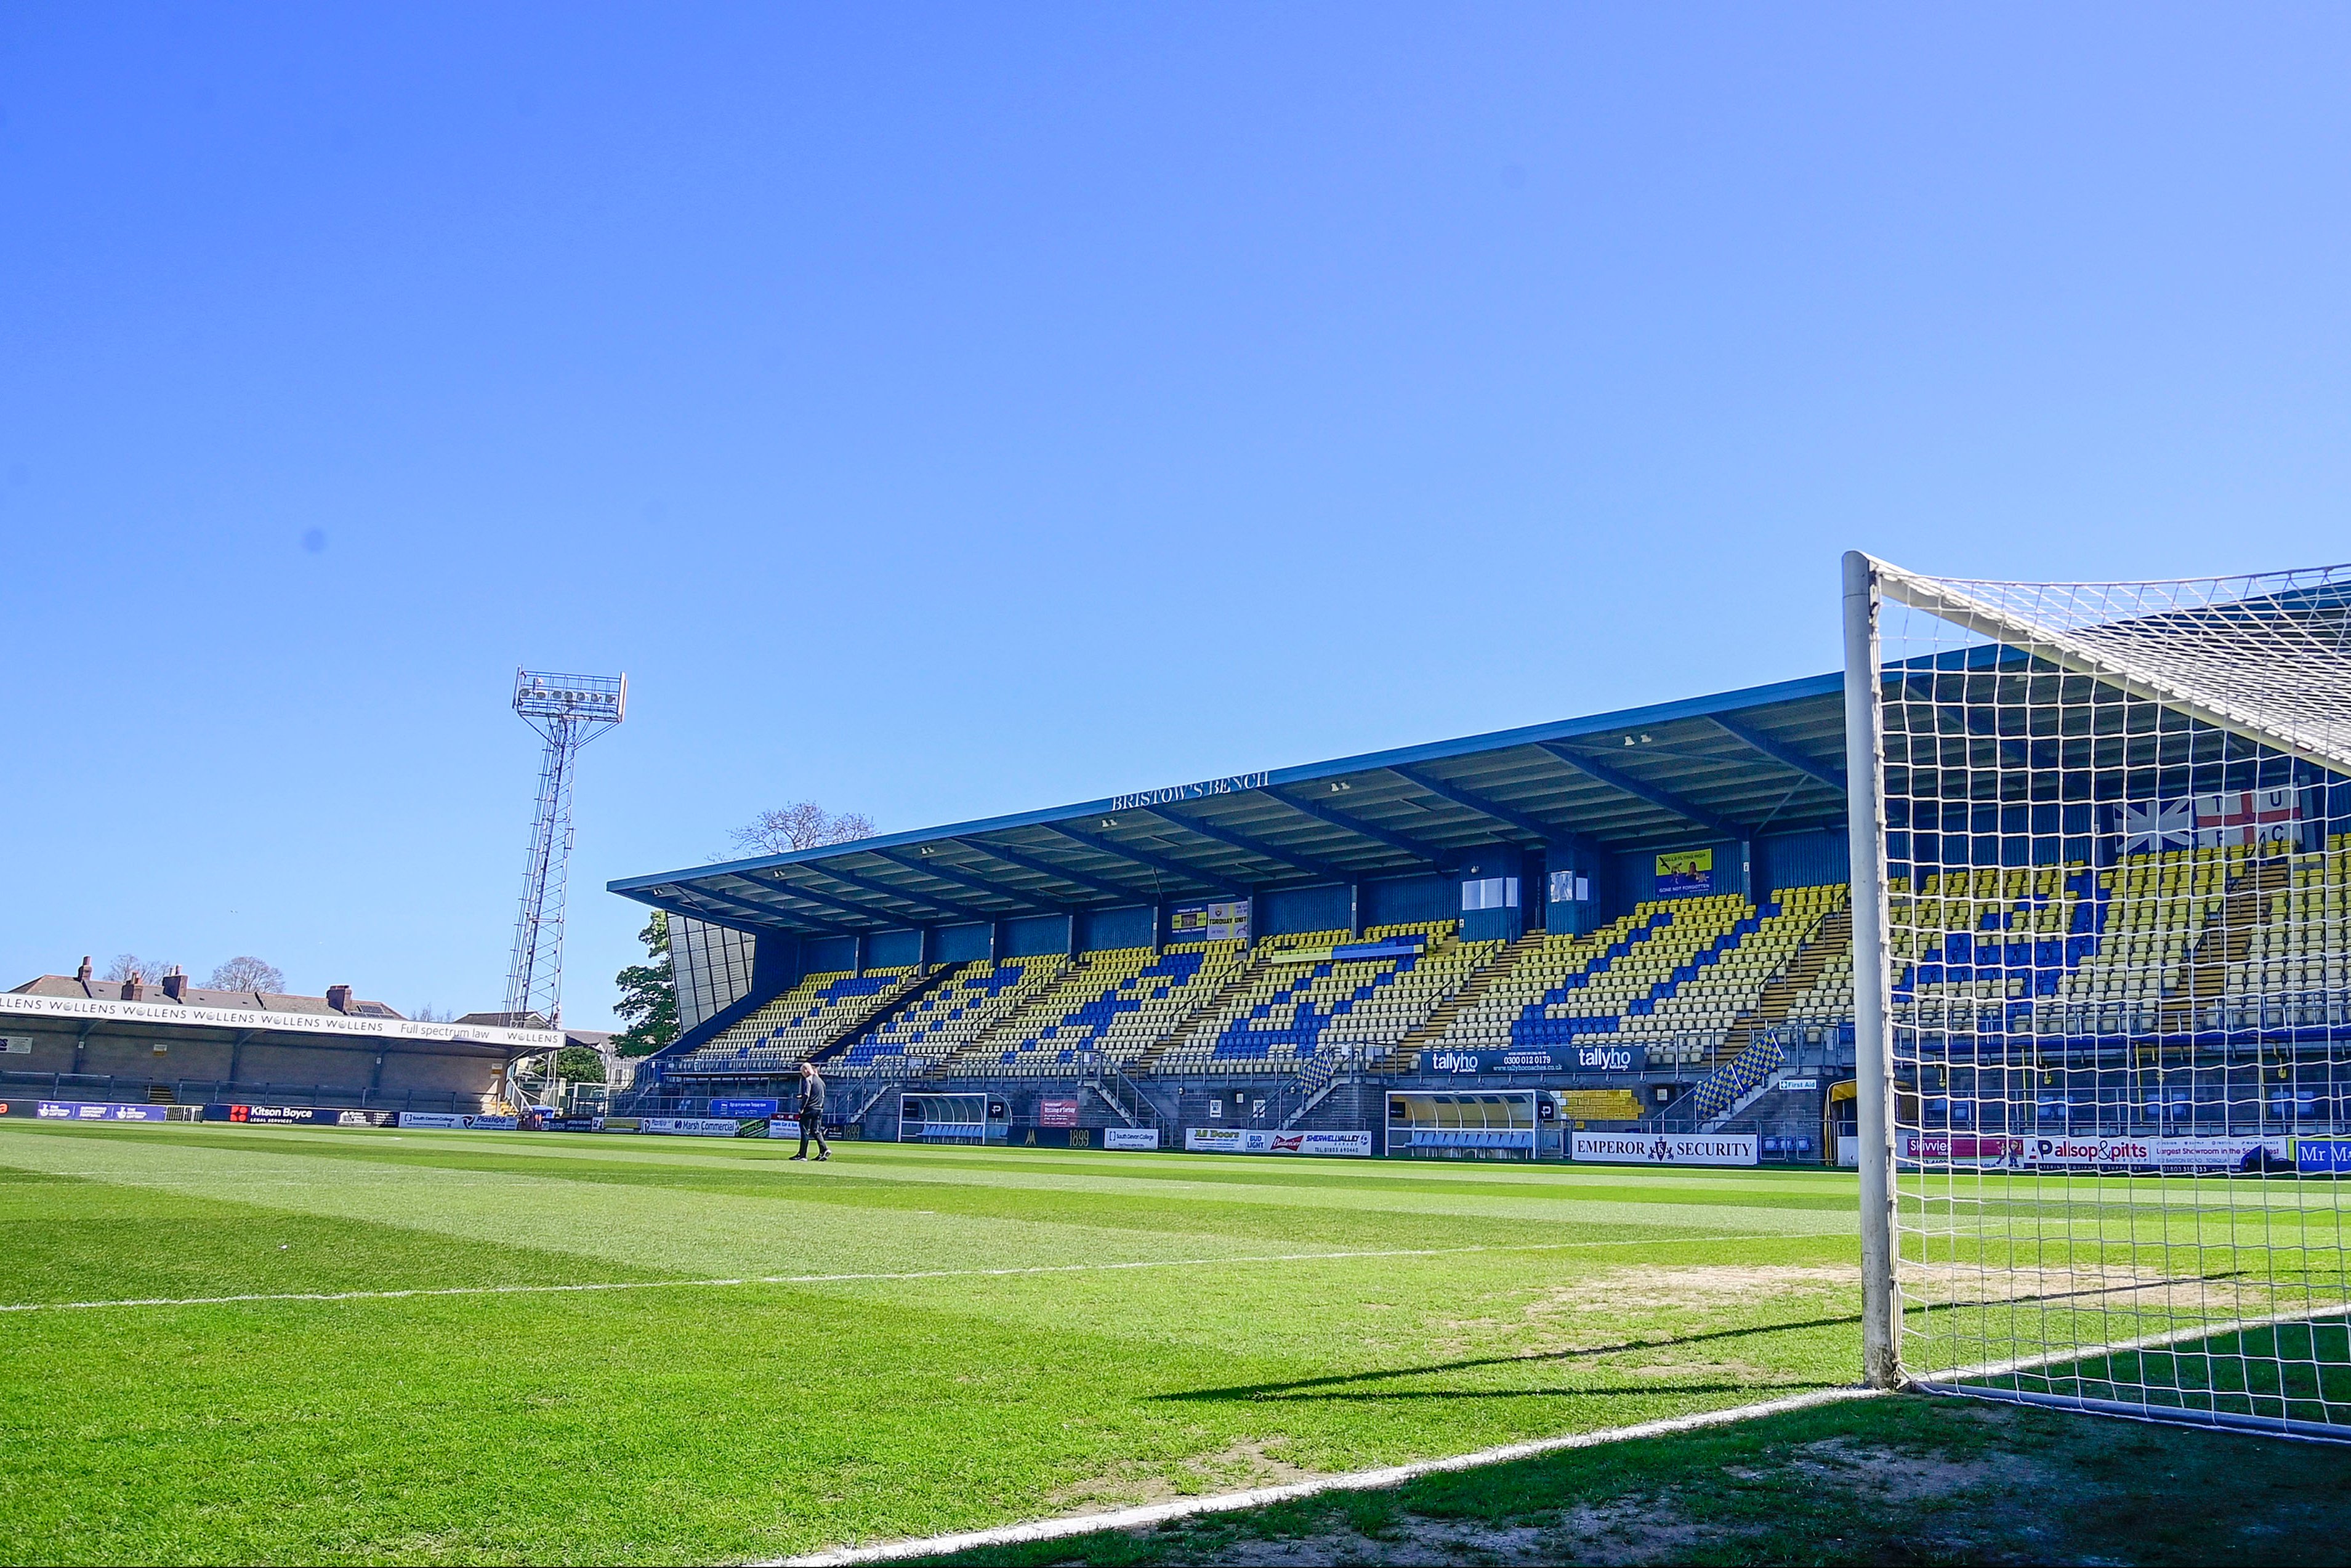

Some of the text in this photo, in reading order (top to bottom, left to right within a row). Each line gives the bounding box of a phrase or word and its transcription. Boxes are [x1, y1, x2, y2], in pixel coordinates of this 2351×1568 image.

[1111, 770, 1270, 811] BRISTOW'S BENCH
[2270, 790, 2283, 807] U
[2271, 825, 2284, 842] C
[0, 997, 558, 1043] LLENS WOLLENS WOLLENS WOLLENS WOLLENS WOLLENS Full spectrum law WOLLENS
[1432, 1052, 1478, 1073] tallyho
[1504, 1055, 1551, 1064] 0300 012 0179
[1579, 1047, 1631, 1070] tallyho
[251, 1106, 313, 1119] Kitson Boyce
[683, 1120, 700, 1130] Marsh
[701, 1121, 734, 1132] Commercial
[844, 1124, 860, 1140] 1899
[1209, 1129, 1240, 1138] Doors
[1069, 1129, 1089, 1147] 1899
[1578, 1140, 1645, 1154] EMPEROR
[1677, 1142, 1752, 1156] SECURITY
[2300, 1146, 2326, 1162] Mr
